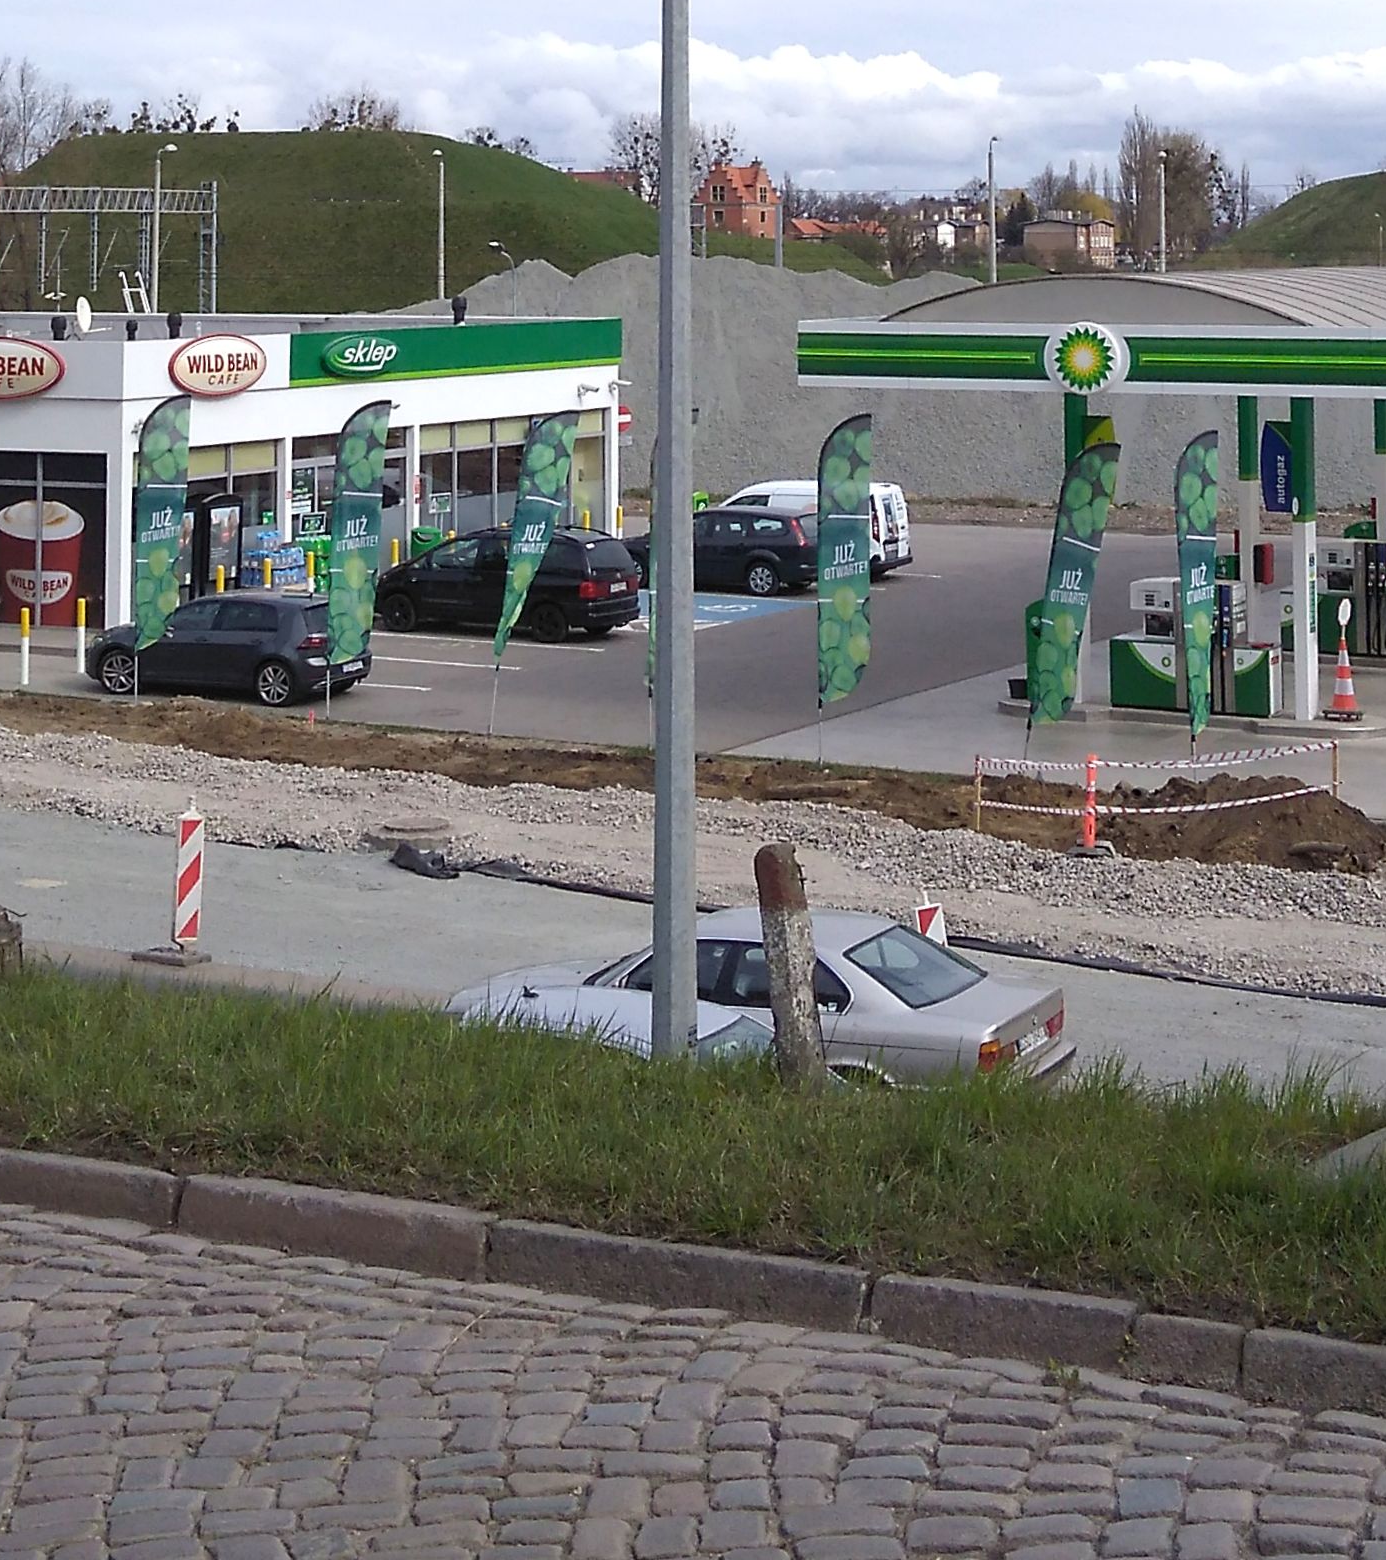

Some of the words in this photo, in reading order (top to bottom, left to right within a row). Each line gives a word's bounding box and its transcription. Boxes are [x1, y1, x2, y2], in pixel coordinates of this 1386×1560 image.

[187, 355, 224, 374] WILD
[228, 352, 258, 373] BEAN
[343, 339, 398, 371] sklep
[208, 373, 239, 386] CAFE
[1276, 455, 1287, 504] autogaz
[150, 506, 173, 530] JUŻ
[344, 515, 368, 538] JUŻ
[521, 521, 546, 541] JUŻ
[833, 539, 856, 565] JUŻ
[10, 574, 37, 591] WILD
[42, 575, 69, 592] BEAN
[1059, 567, 1083, 590] JUŻ
[1190, 561, 1207, 589] JUŻ
